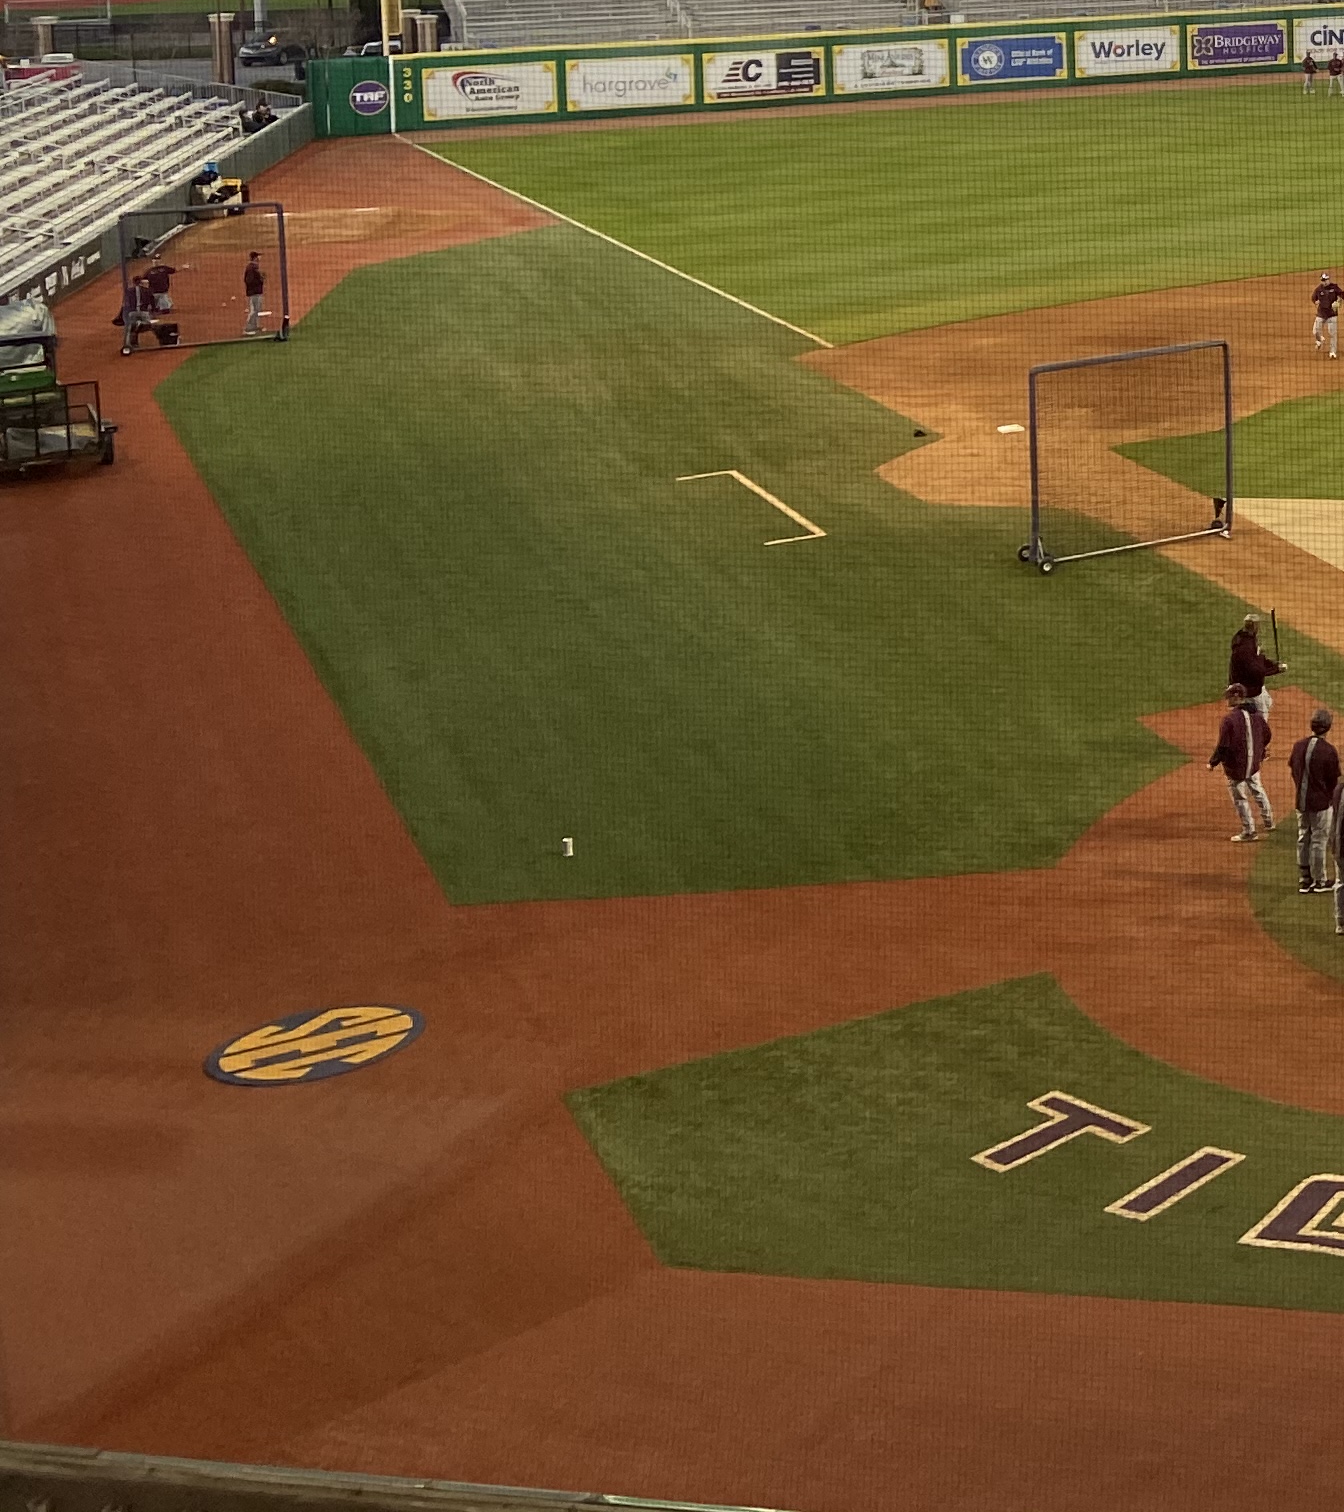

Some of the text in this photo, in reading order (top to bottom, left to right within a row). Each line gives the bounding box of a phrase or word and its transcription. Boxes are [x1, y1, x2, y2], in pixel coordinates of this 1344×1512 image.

[1214, 34, 1281, 48] BRIDGEWAY
[1091, 39, 1166, 60] Worley
[1222, 45, 1270, 54] HOSPICE
[402, 68, 413, 103] 330
[465, 77, 495, 87] North
[583, 72, 669, 97] hargrove
[469, 85, 520, 95] American
